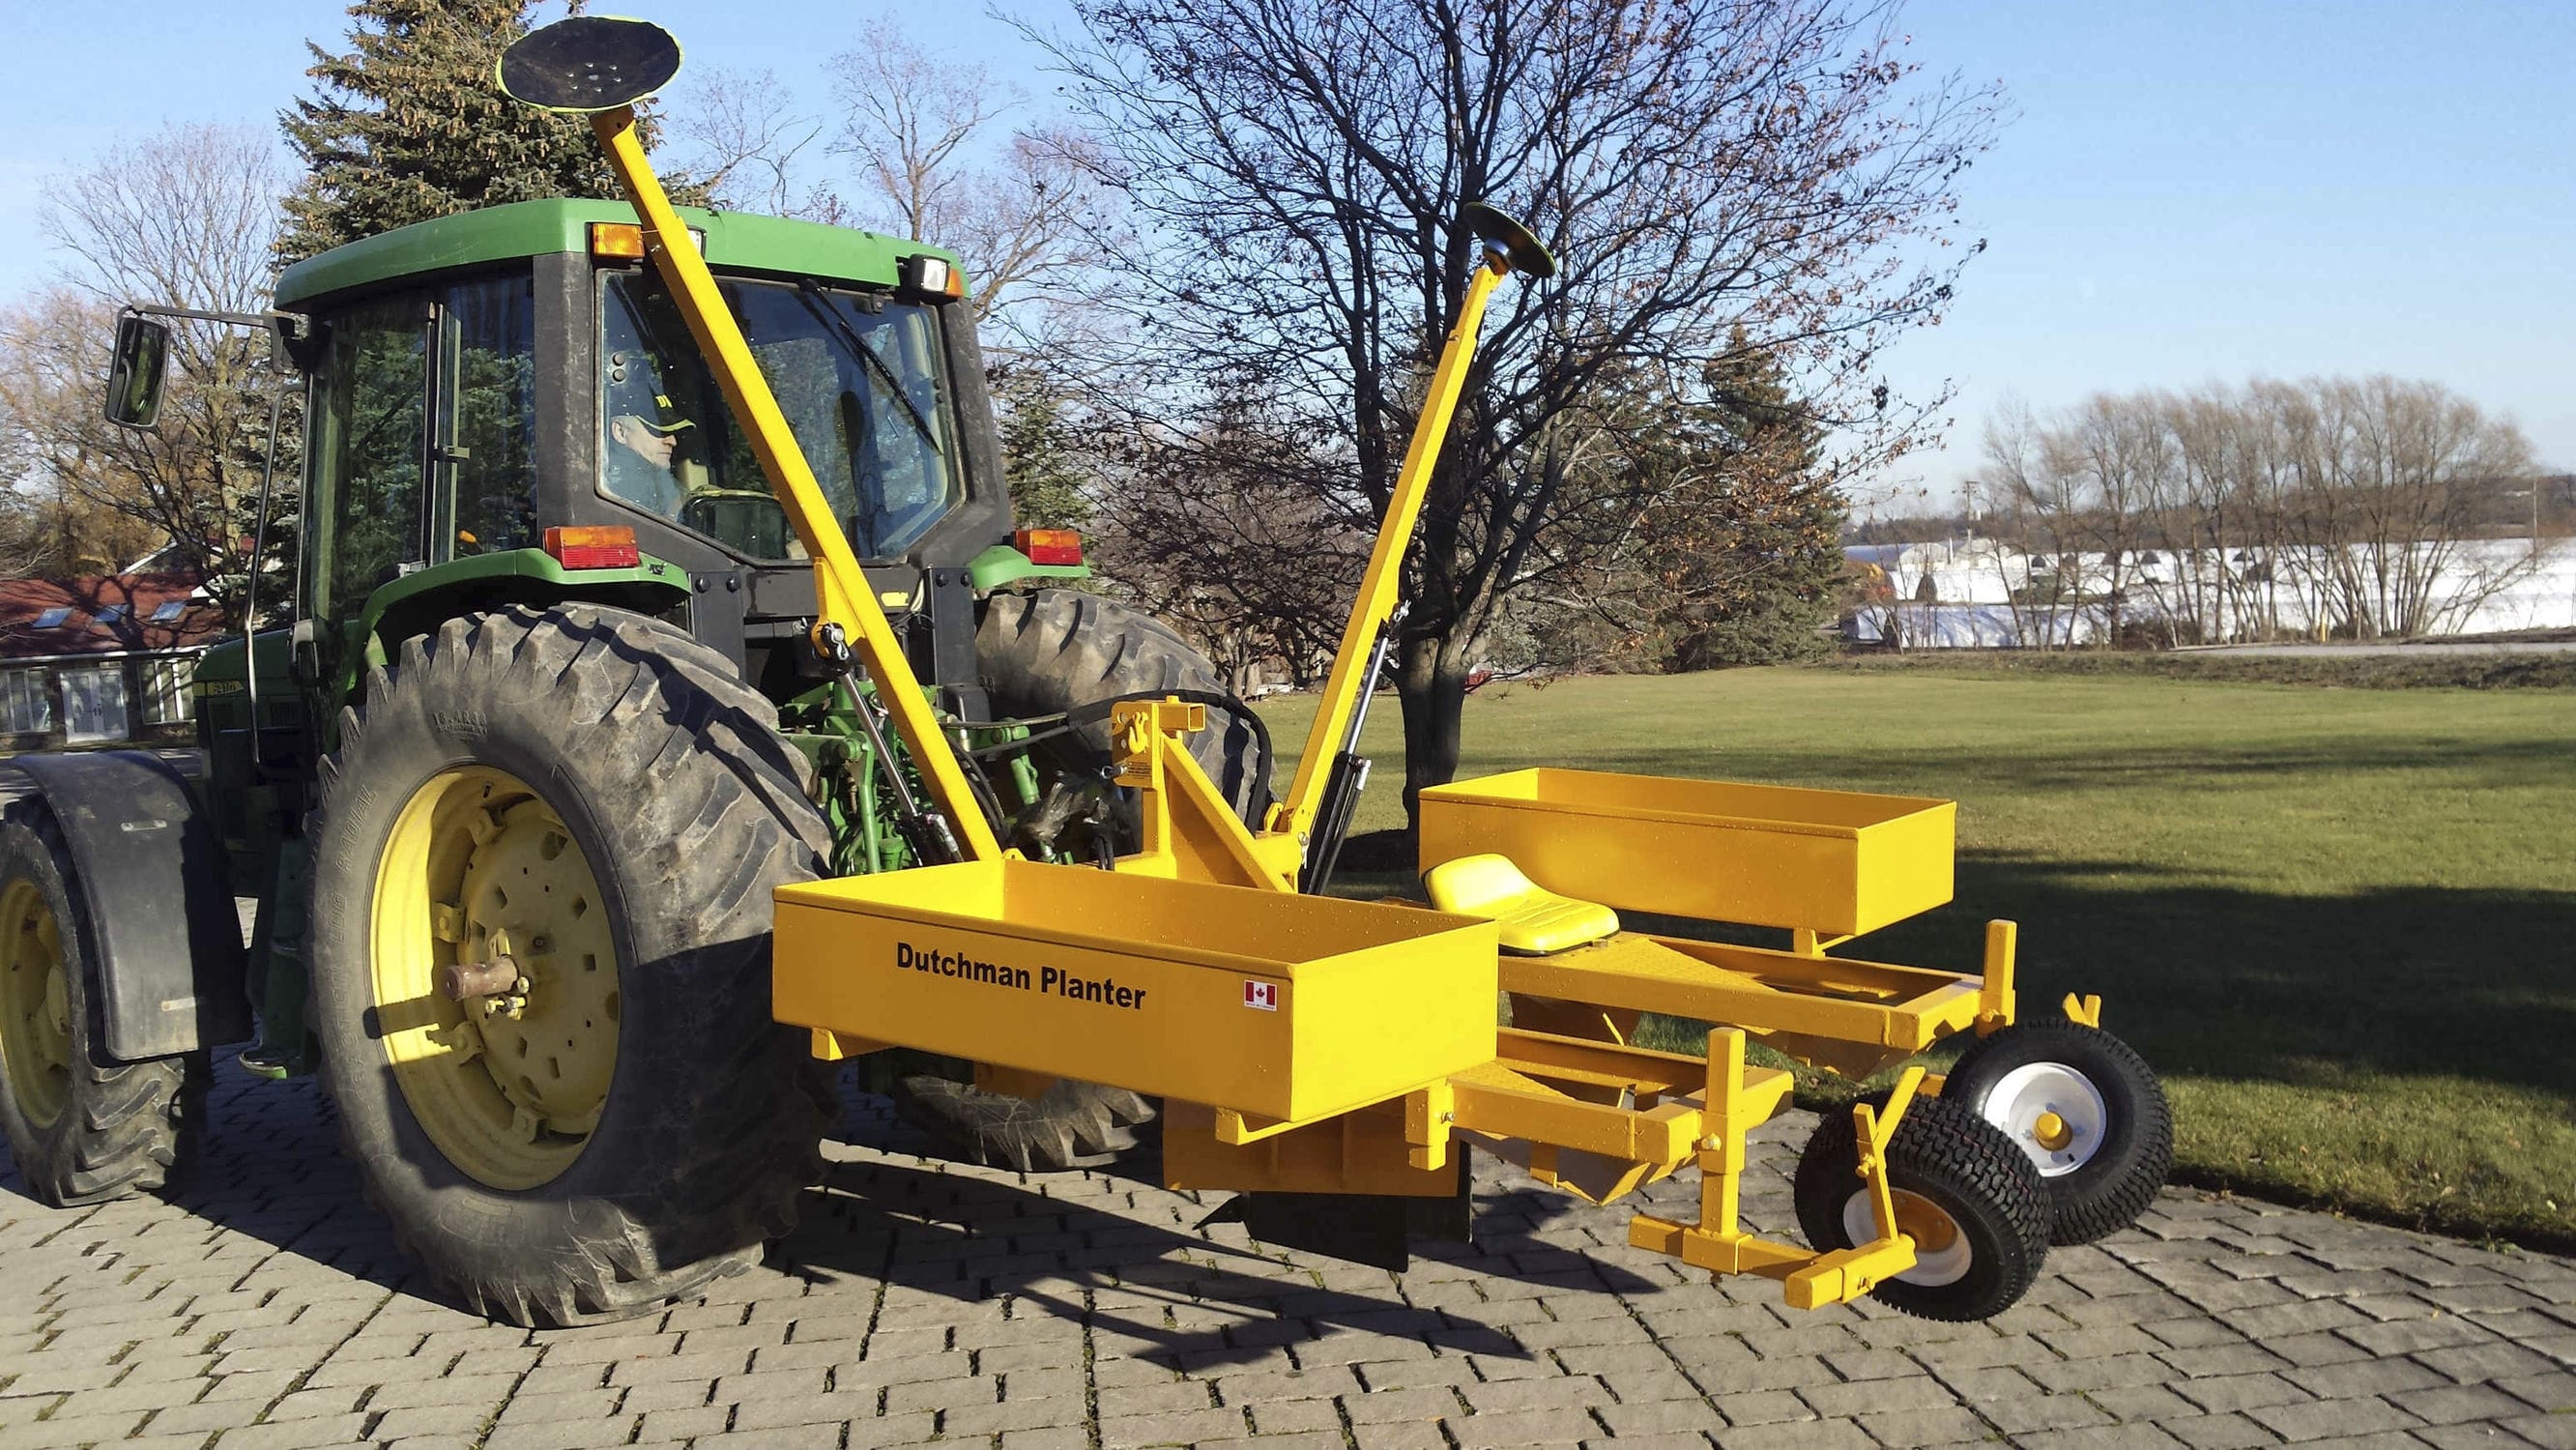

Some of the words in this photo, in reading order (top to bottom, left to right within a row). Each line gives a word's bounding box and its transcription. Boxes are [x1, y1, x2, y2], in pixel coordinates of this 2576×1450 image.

[334, 784, 378, 873] RADIAL
[897, 942, 1030, 991] Dutchman
[1041, 966, 1146, 1010] Planter
